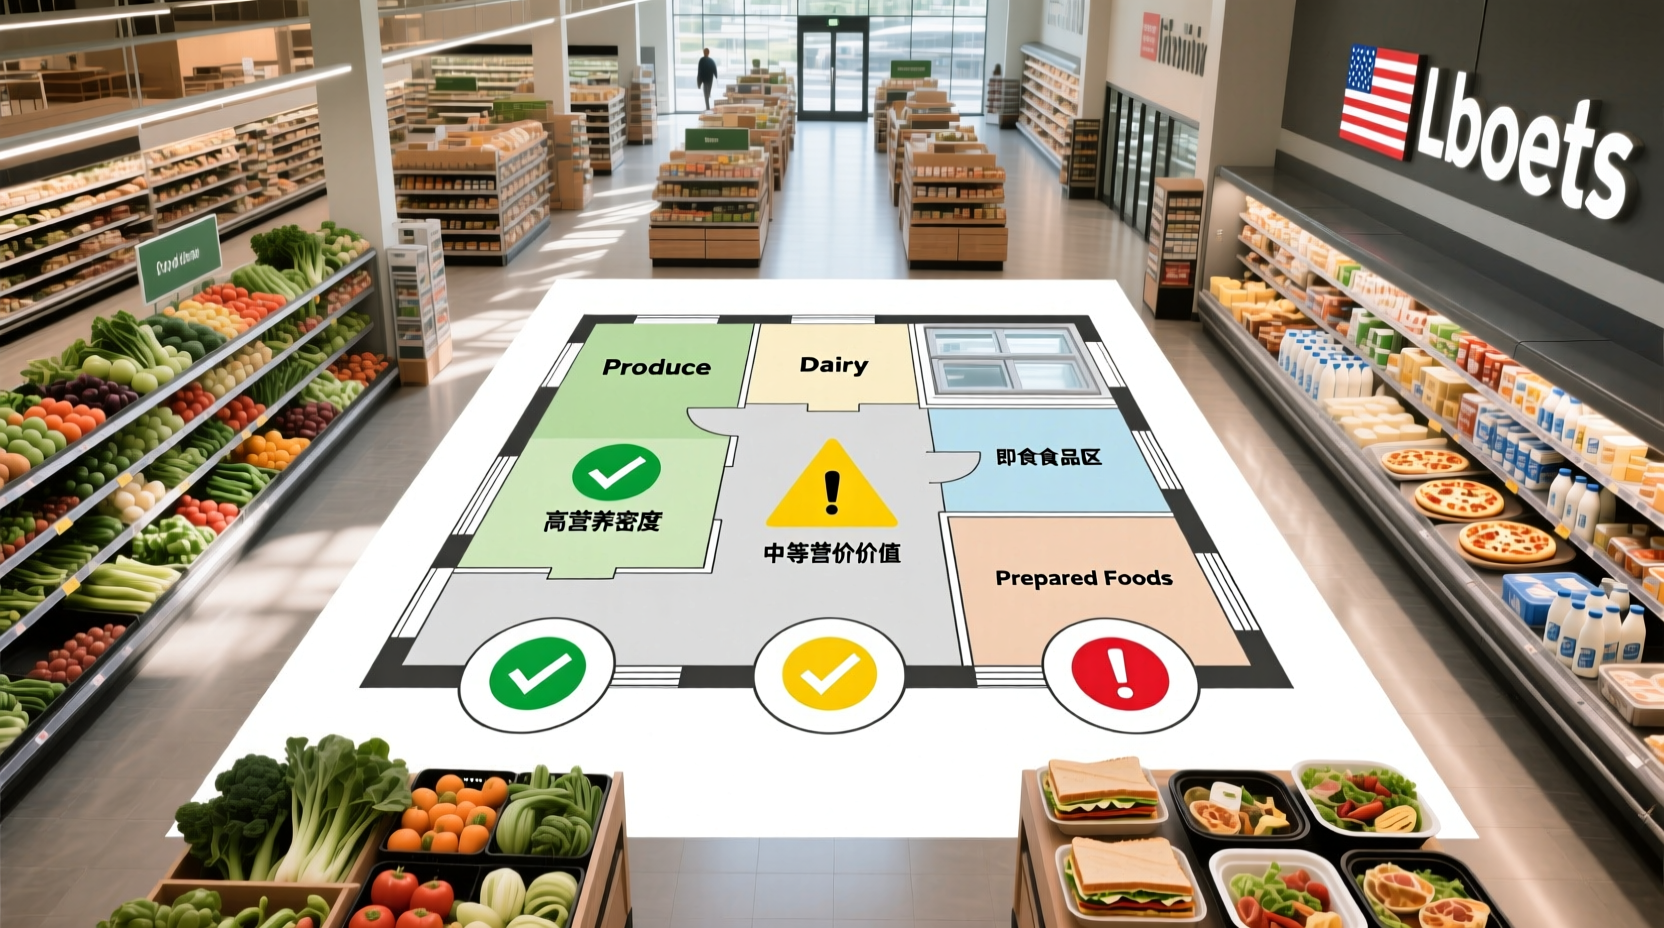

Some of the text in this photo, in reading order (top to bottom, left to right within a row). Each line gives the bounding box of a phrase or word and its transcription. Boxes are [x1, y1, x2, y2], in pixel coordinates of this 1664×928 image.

[1417, 65, 1635, 220] Lboets
[602, 358, 712, 376] Produce
[800, 356, 869, 378] Dairy
[996, 447, 1103, 467] 即食食品区
[543, 509, 664, 533] 高营养密度
[763, 541, 902, 564] 中等营价价值
[996, 569, 1174, 591] Prepared Foods
